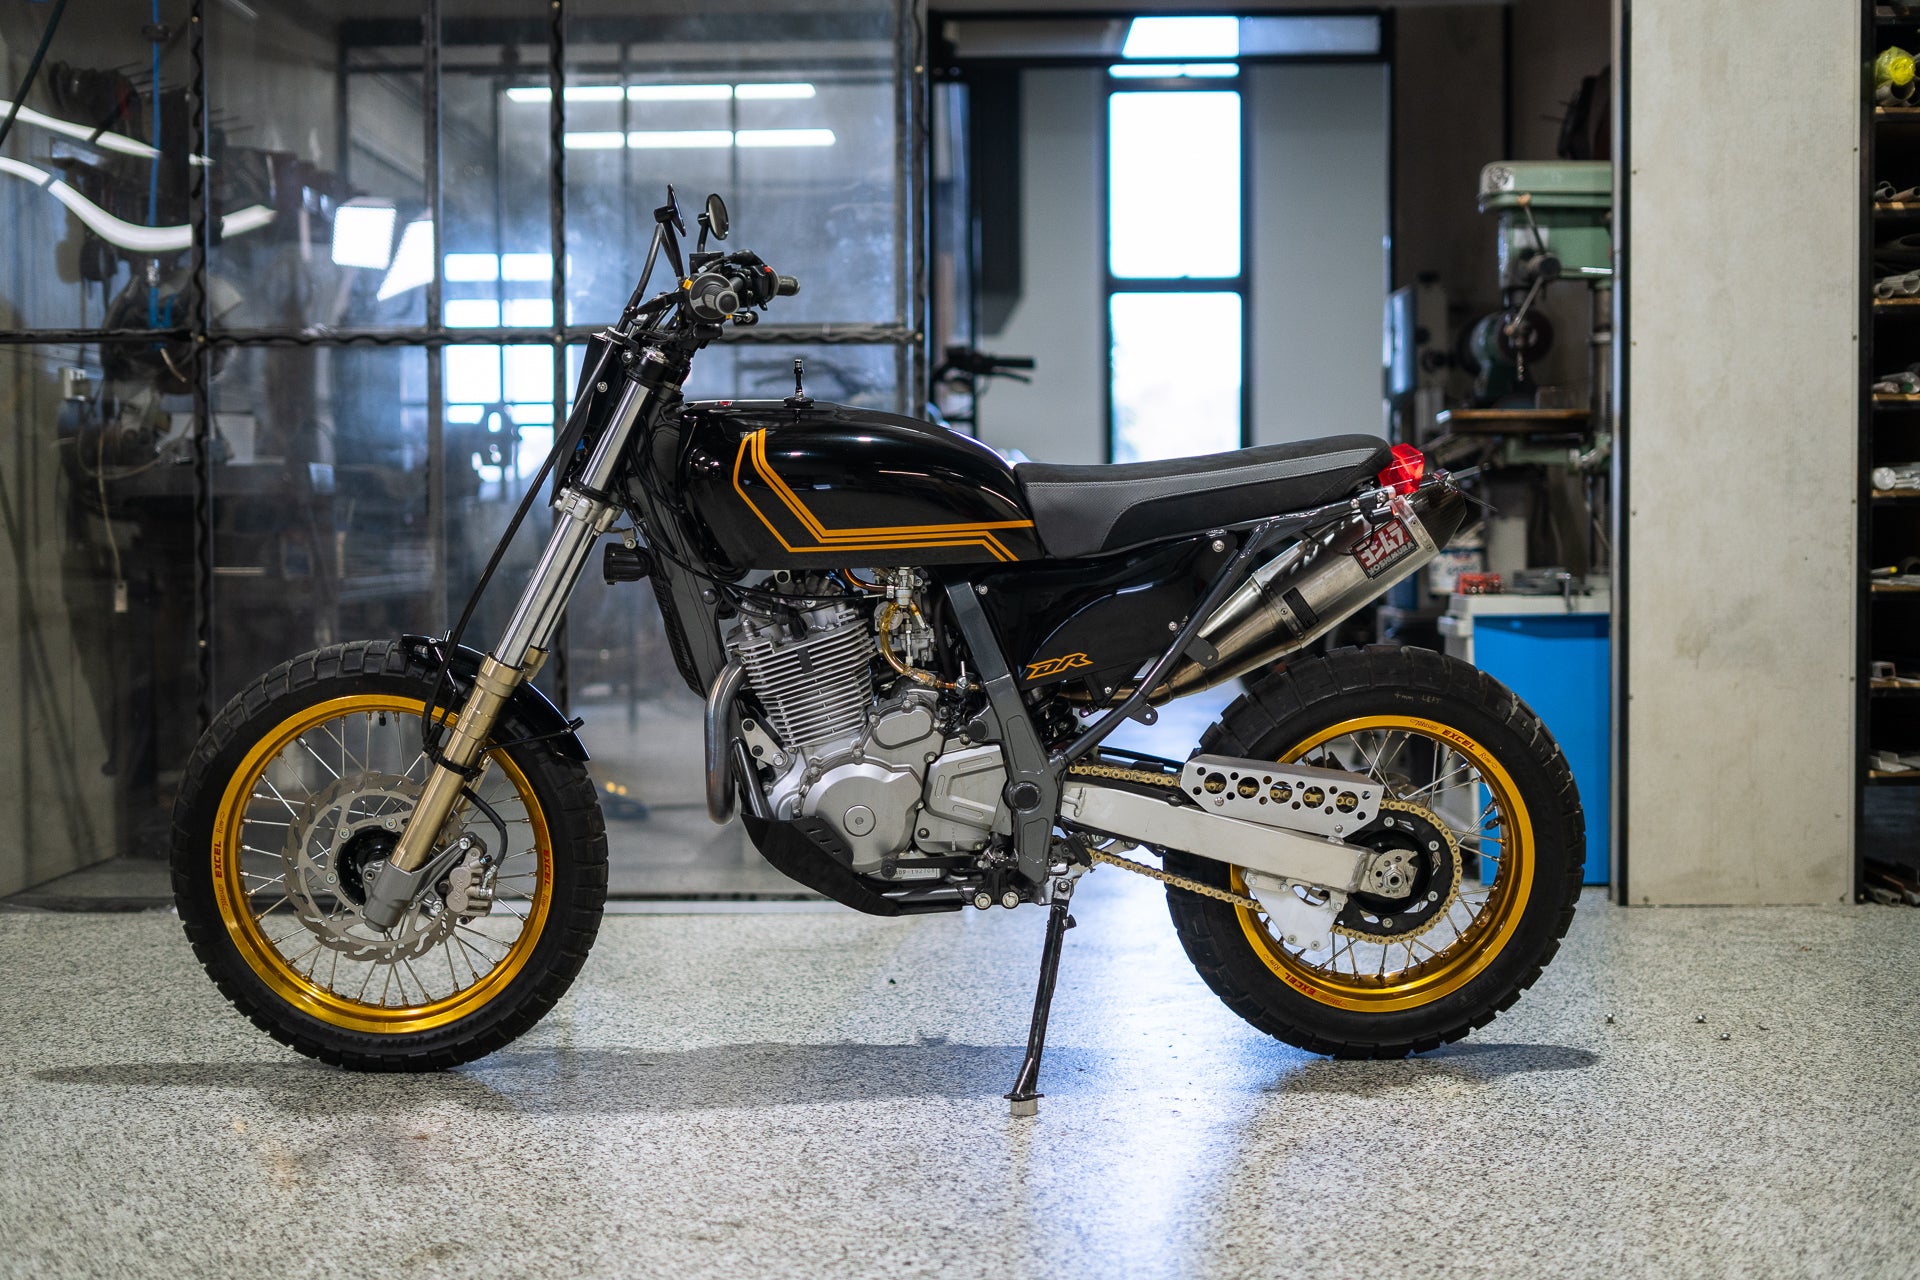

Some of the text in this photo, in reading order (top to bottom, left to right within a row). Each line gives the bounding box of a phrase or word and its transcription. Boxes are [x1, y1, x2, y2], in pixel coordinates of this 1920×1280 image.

[1367, 541, 1415, 575] YOSHIMURA
[1026, 652, 1094, 680] DR
[1442, 729, 1475, 751] EXCEL
[214, 840, 222, 878] EXCEL
[543, 849, 551, 886] EXCEL
[1284, 972, 1316, 995] EXCEL
